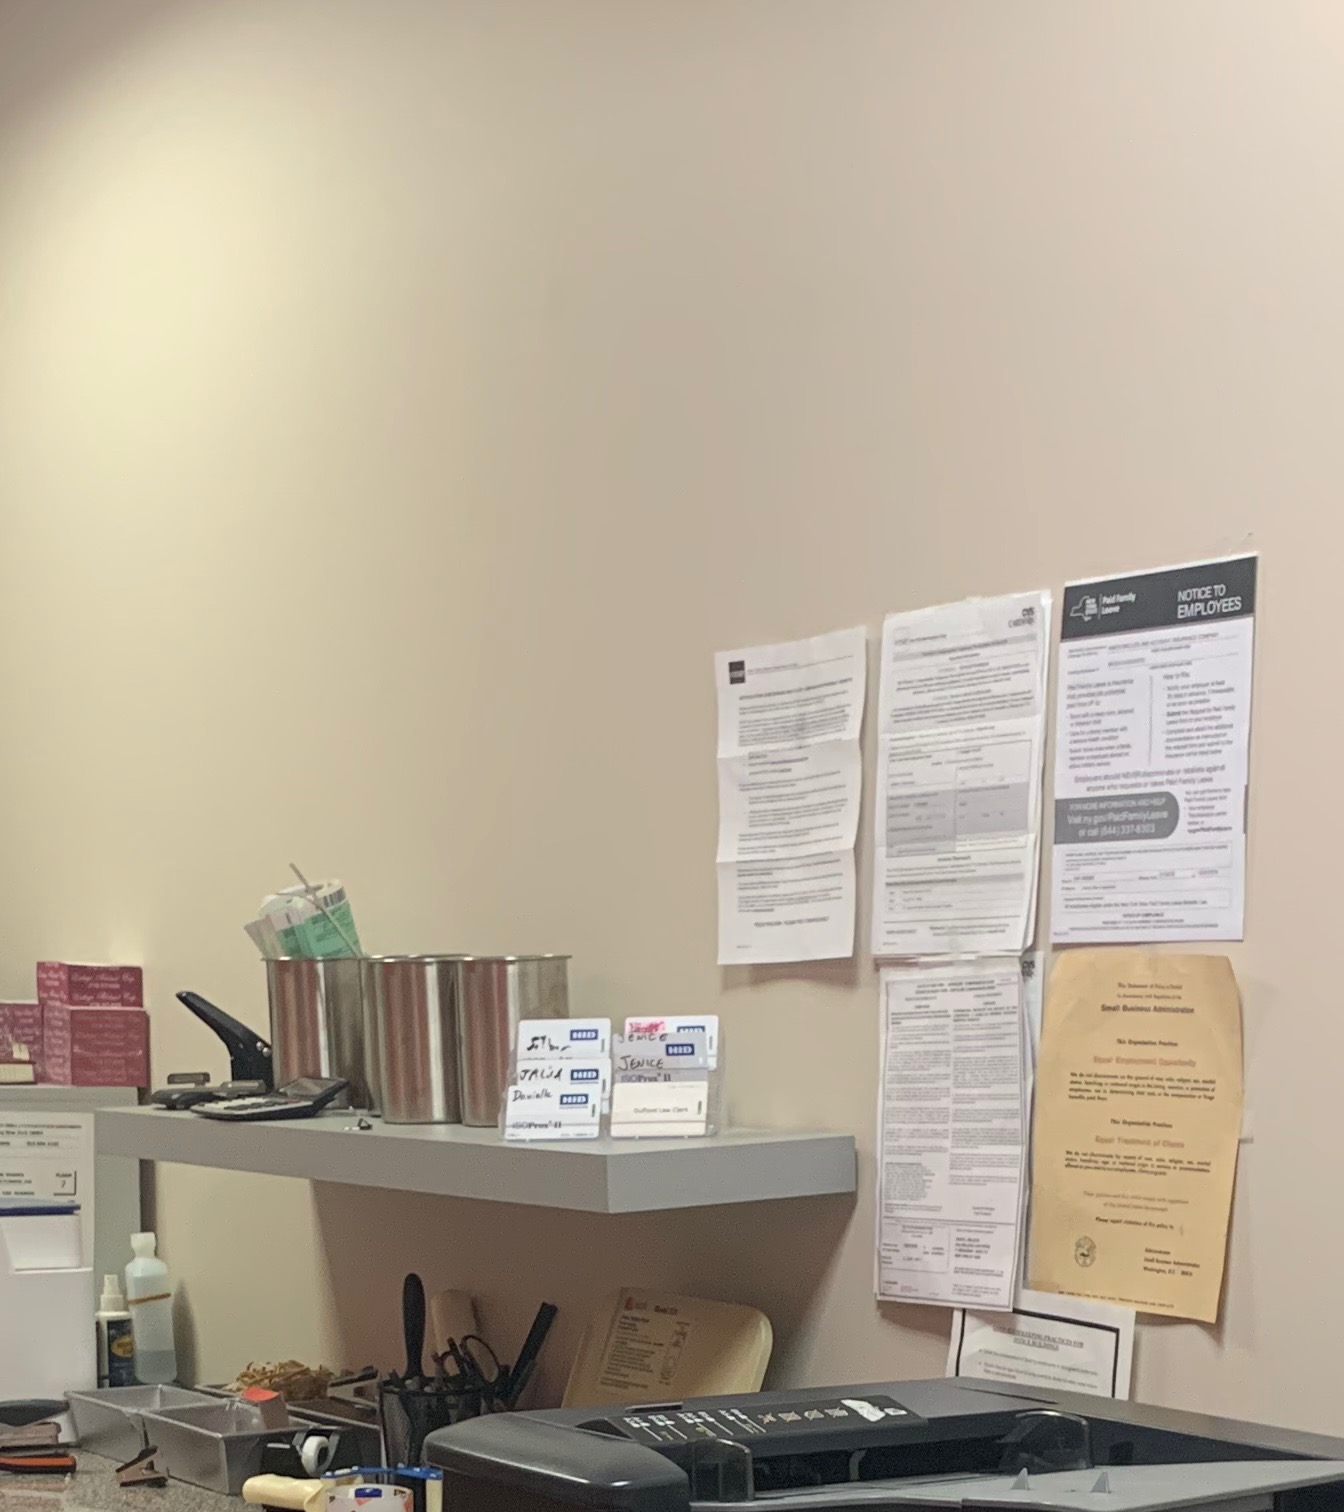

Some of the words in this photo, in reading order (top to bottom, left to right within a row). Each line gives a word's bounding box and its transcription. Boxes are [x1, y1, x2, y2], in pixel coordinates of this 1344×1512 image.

[1177, 586, 1212, 602] NOTICE
[1213, 584, 1226, 597] TO
[1102, 594, 1116, 604] Paid
[1177, 596, 1242, 619] EMPLOYEES
[1122, 1004, 1151, 1012] Business
[667, 1045, 694, 1055] HID
